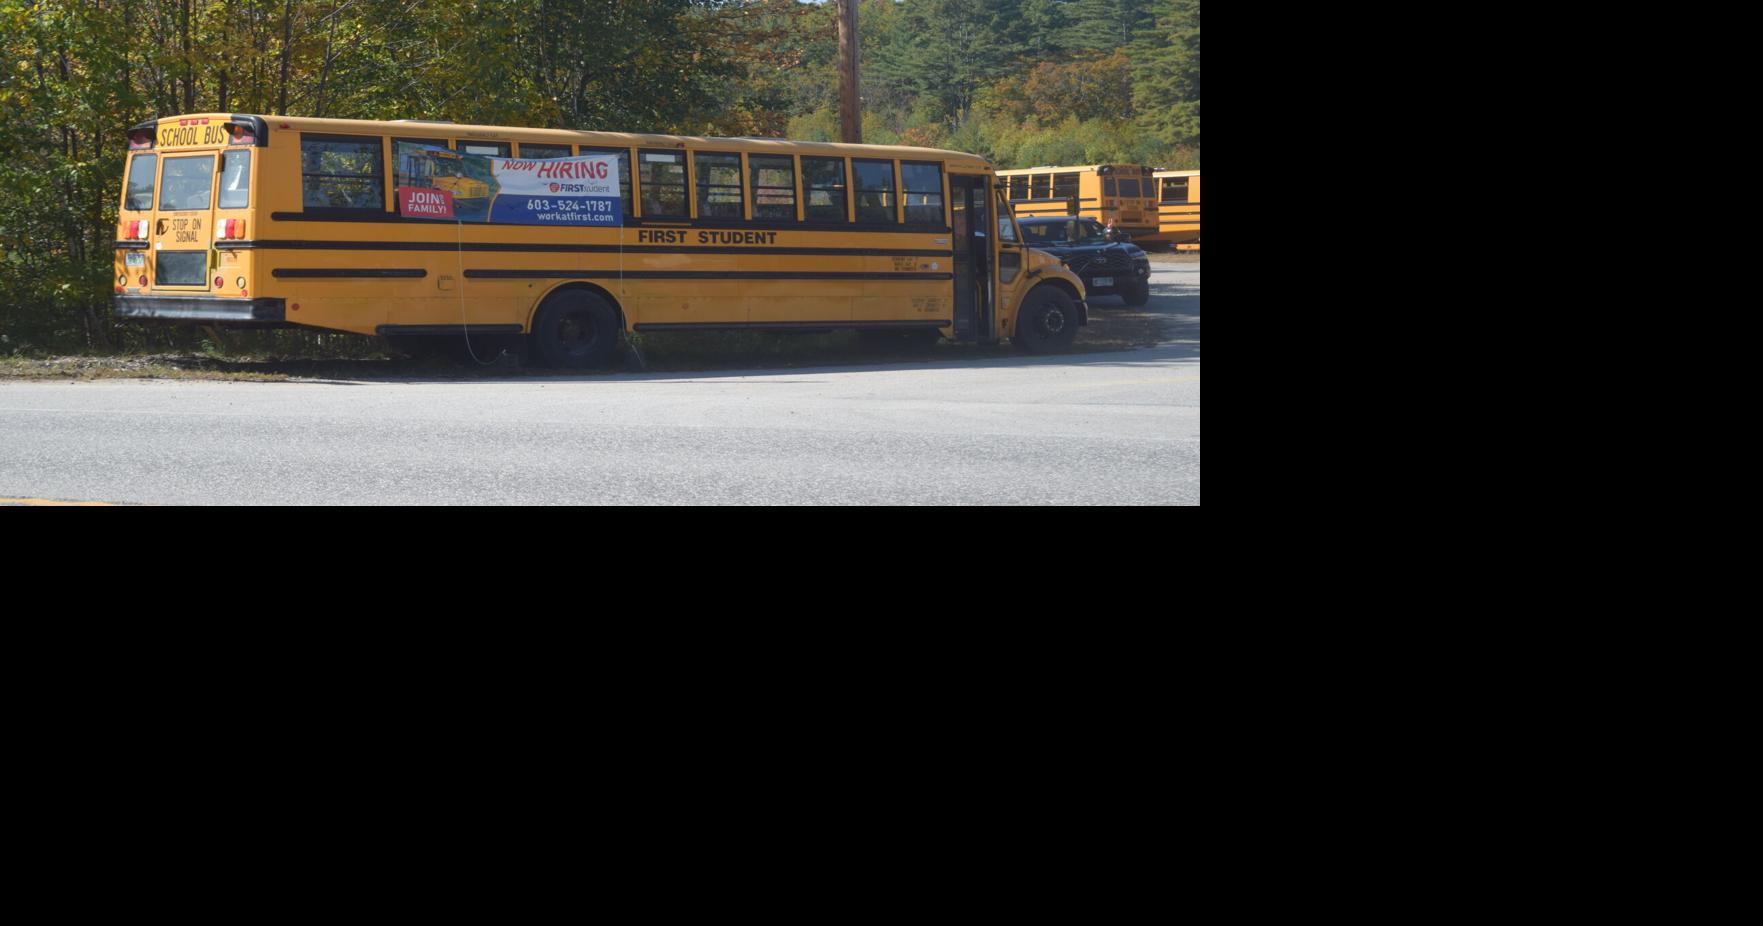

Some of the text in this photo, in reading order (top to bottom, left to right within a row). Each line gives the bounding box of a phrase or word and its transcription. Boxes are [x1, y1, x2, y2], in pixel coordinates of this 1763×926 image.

[160, 125, 224, 146] SCHOOL BUS
[502, 160, 609, 179] NOW HIRING
[408, 191, 441, 204] JOIN
[408, 203, 447, 214] FAMILY!
[527, 199, 612, 212] 603-524-1787
[536, 211, 614, 222] workatfirst.com
[172, 218, 202, 231] STOP ON
[175, 231, 198, 242] SIGNAL
[638, 230, 777, 244] FIRST STUDENT
